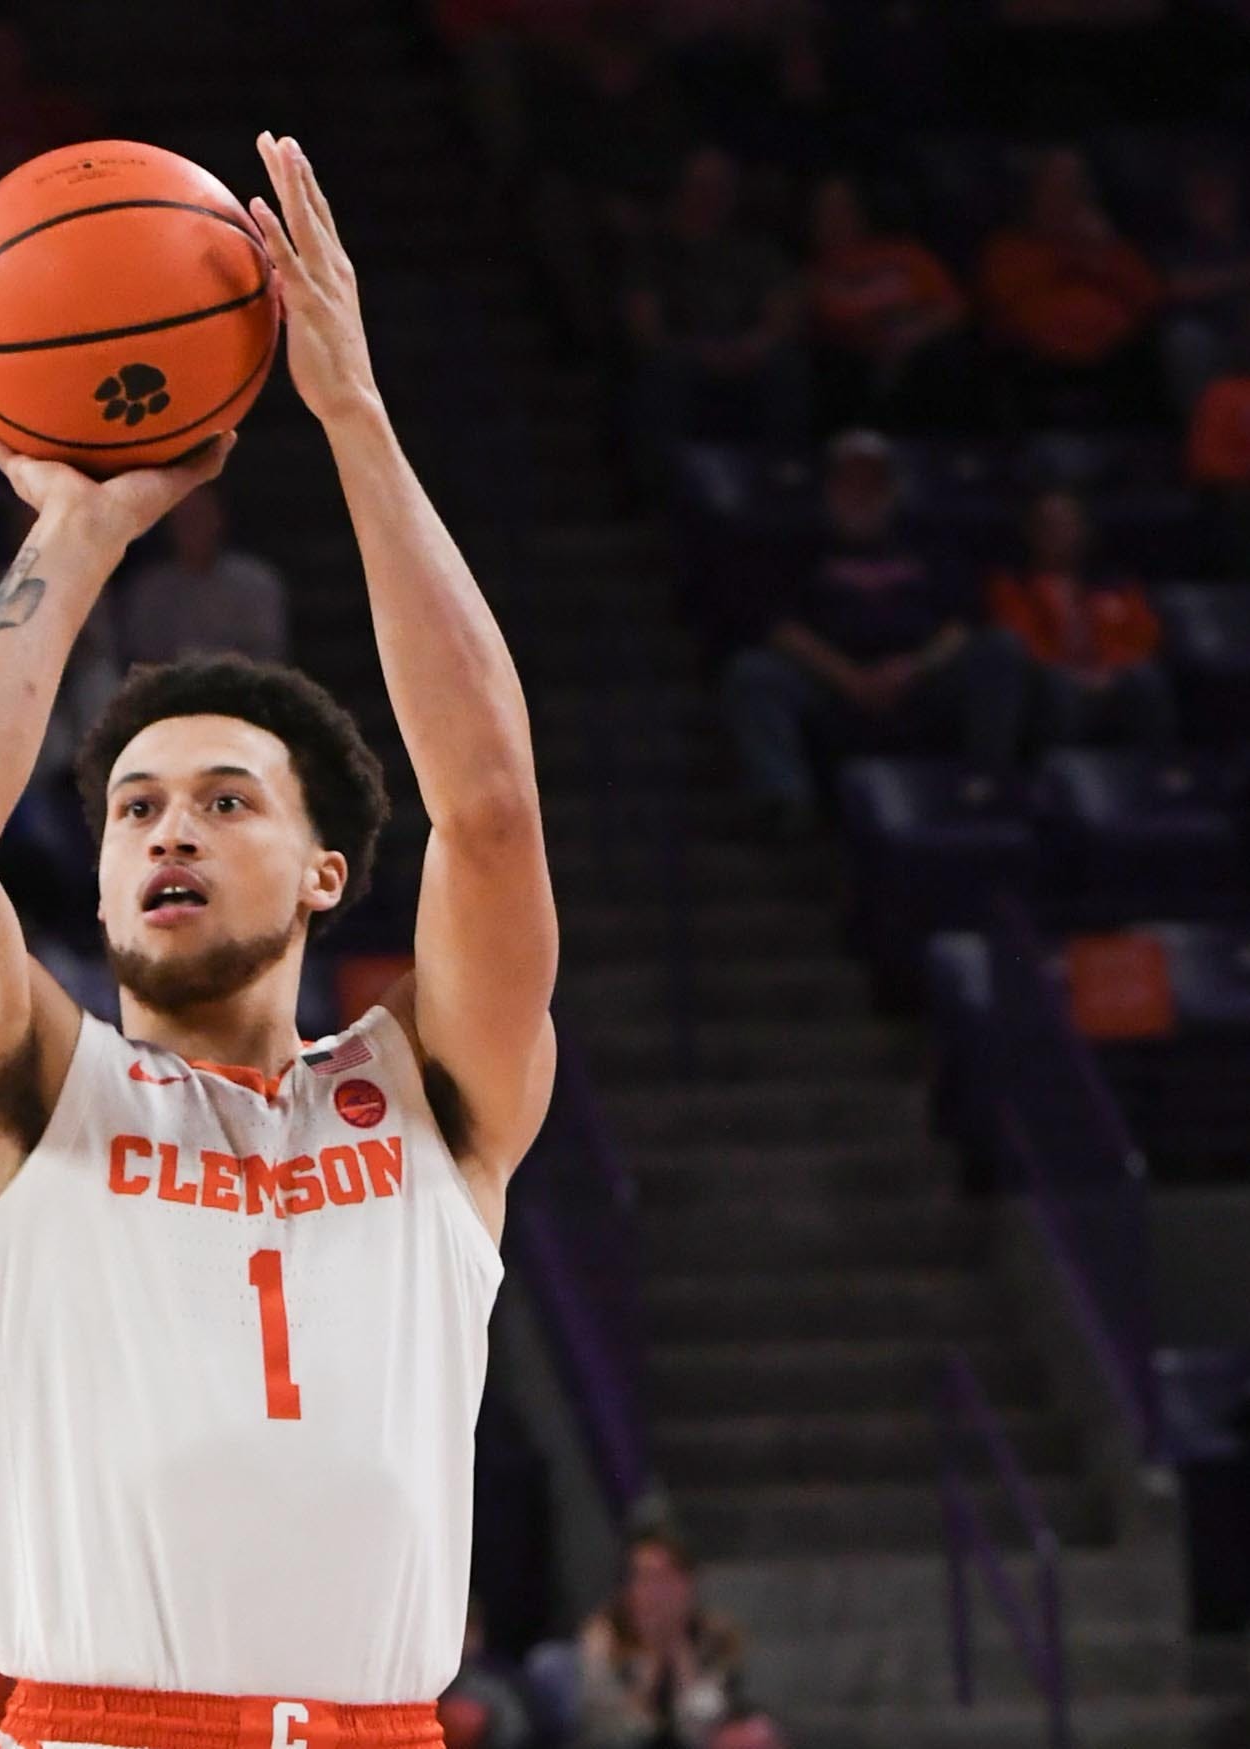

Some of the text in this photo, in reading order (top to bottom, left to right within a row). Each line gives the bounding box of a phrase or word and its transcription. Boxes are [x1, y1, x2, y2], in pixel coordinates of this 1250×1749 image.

[107, 1133, 403, 1219] CLEMSON
[247, 1249, 302, 1420] 1
[270, 1701, 310, 1749] C
